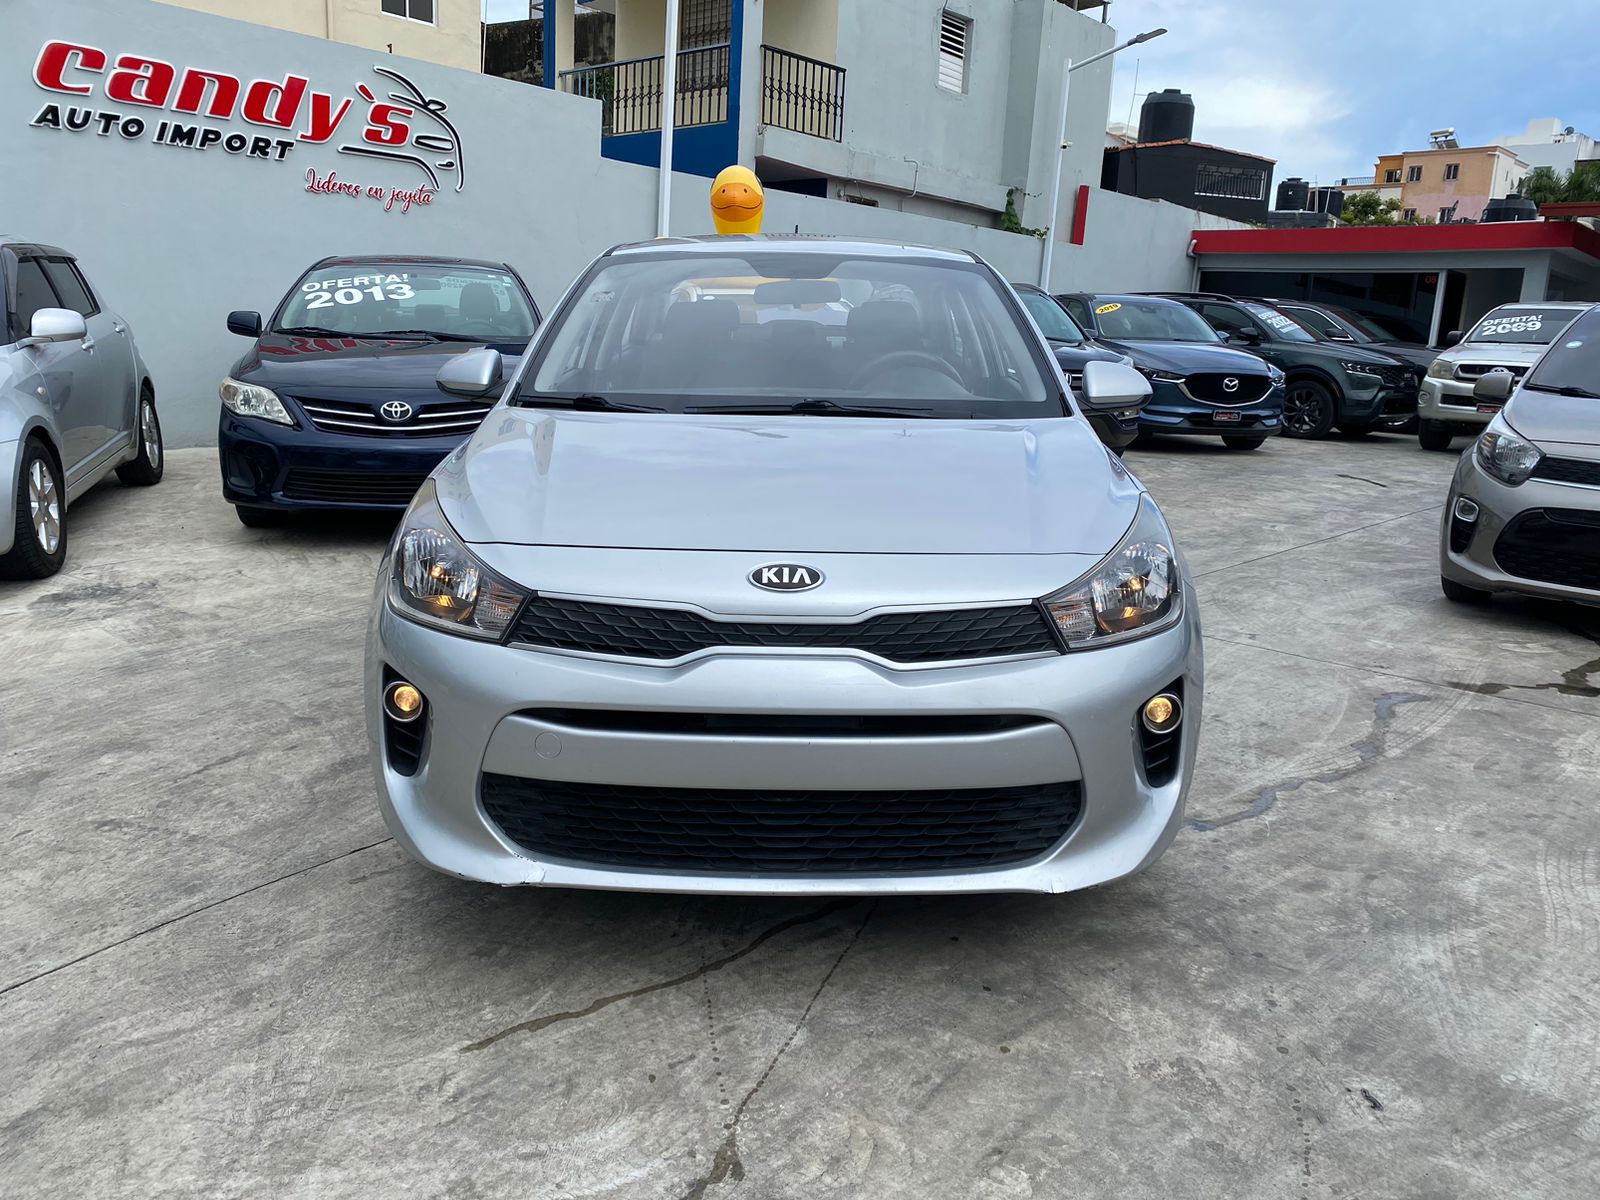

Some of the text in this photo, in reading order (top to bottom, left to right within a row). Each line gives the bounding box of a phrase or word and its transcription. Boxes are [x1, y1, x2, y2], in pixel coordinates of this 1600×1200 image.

[29, 102, 296, 161] AUTO IMPORT
[305, 167, 435, 214] Lideres en joyita
[301, 273, 409, 292] OFERTA!
[304, 283, 416, 310] 2013
[1481, 314, 1543, 326] OFERTA!
[1482, 321, 1542, 336] 2009
[761, 567, 812, 585] KIA
